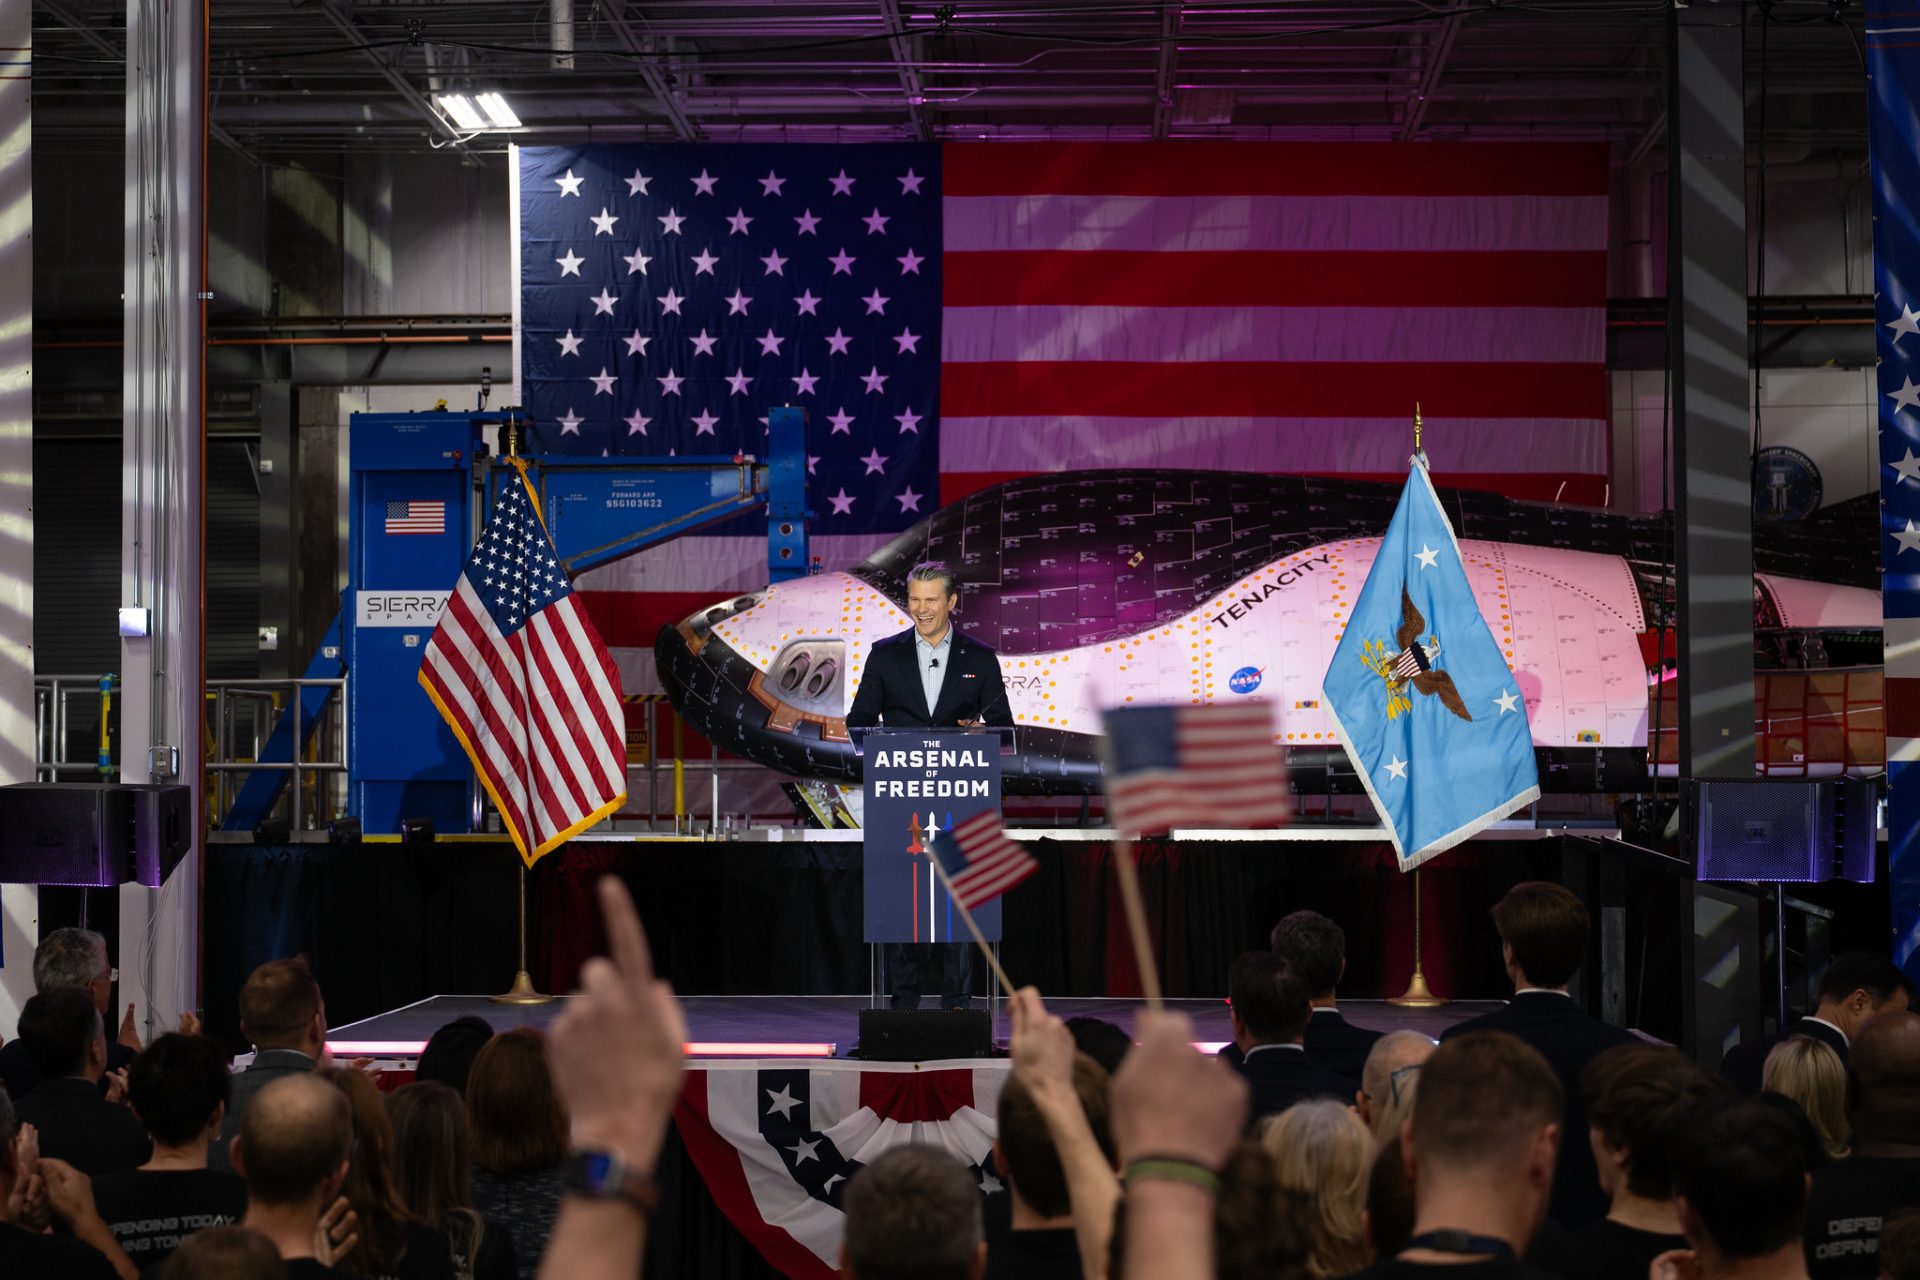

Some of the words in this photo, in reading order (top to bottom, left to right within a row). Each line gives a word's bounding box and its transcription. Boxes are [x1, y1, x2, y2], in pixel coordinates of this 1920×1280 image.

[606, 499, 662, 508] SSG103622
[1211, 553, 1331, 629] TENACITY
[1002, 676, 1042, 689] RRA
[1230, 674, 1261, 687] NASA
[922, 740, 941, 748] THE
[874, 750, 990, 768] ARSENAL
[925, 770, 939, 778] OF
[874, 780, 989, 798] FREEDOM
